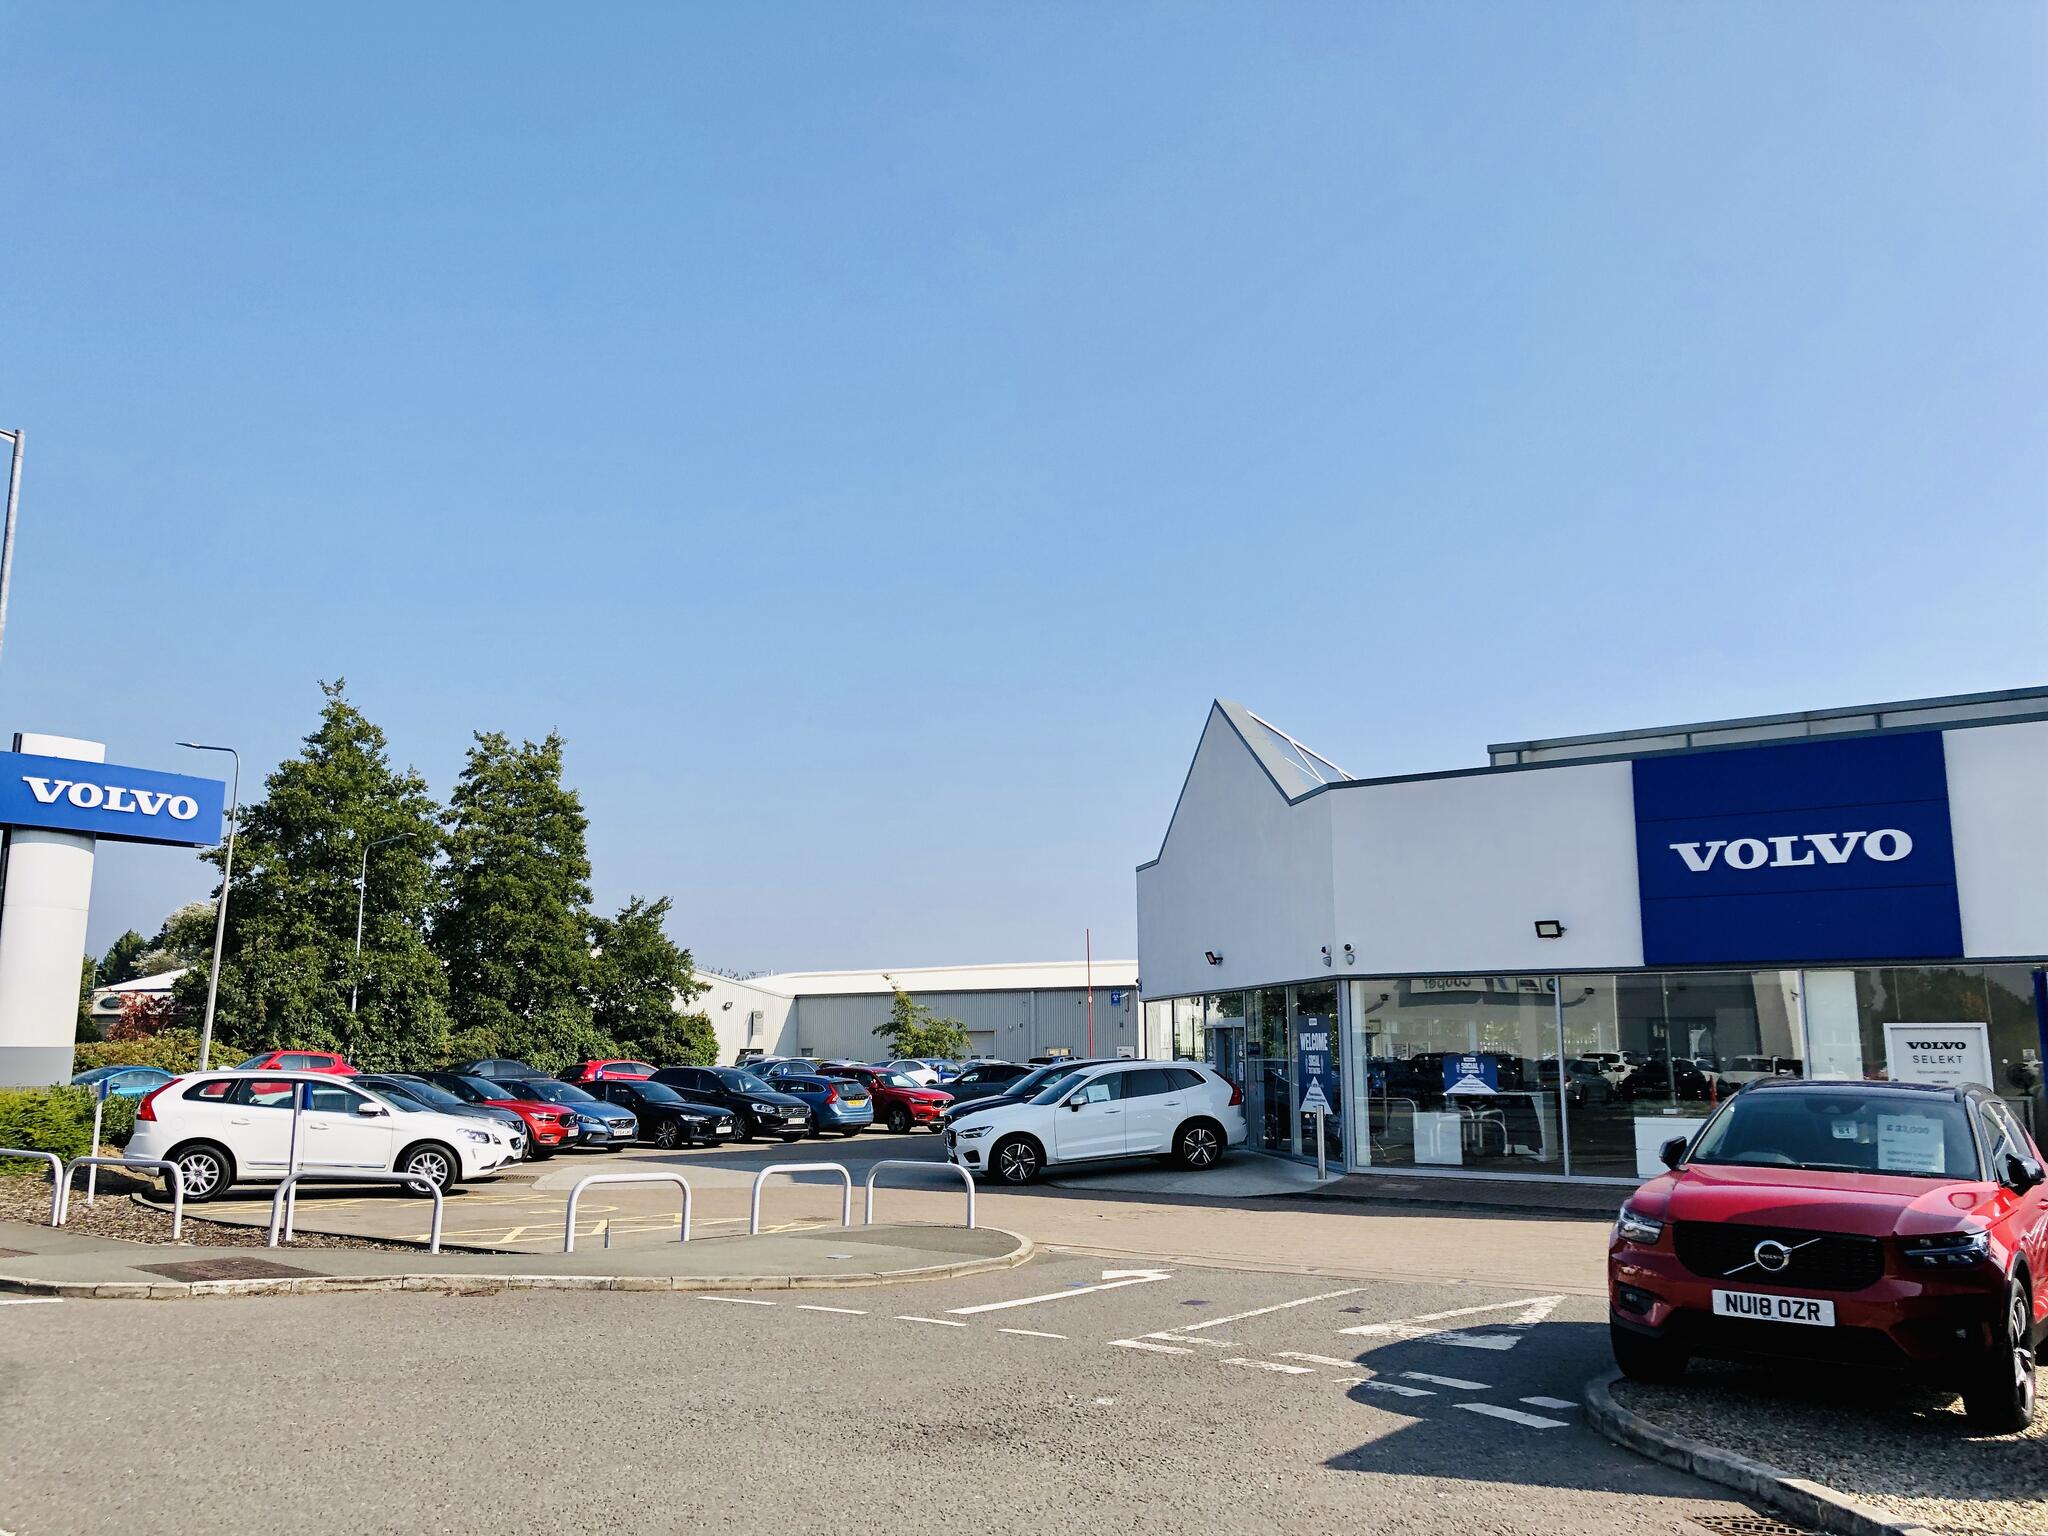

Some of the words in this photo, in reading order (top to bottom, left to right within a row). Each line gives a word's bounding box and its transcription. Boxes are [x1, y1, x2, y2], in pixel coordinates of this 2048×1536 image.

[22, 775, 199, 820] VOLVO
[1669, 828, 1913, 872] VOLVO
[1299, 1032, 1328, 1051] WELCOME
[1906, 1041, 1967, 1050] VOLVO
[1912, 1055, 1963, 1064] SELEKT
[1725, 1293, 1772, 1316] NU18
[1778, 1299, 1821, 1321] OZR
